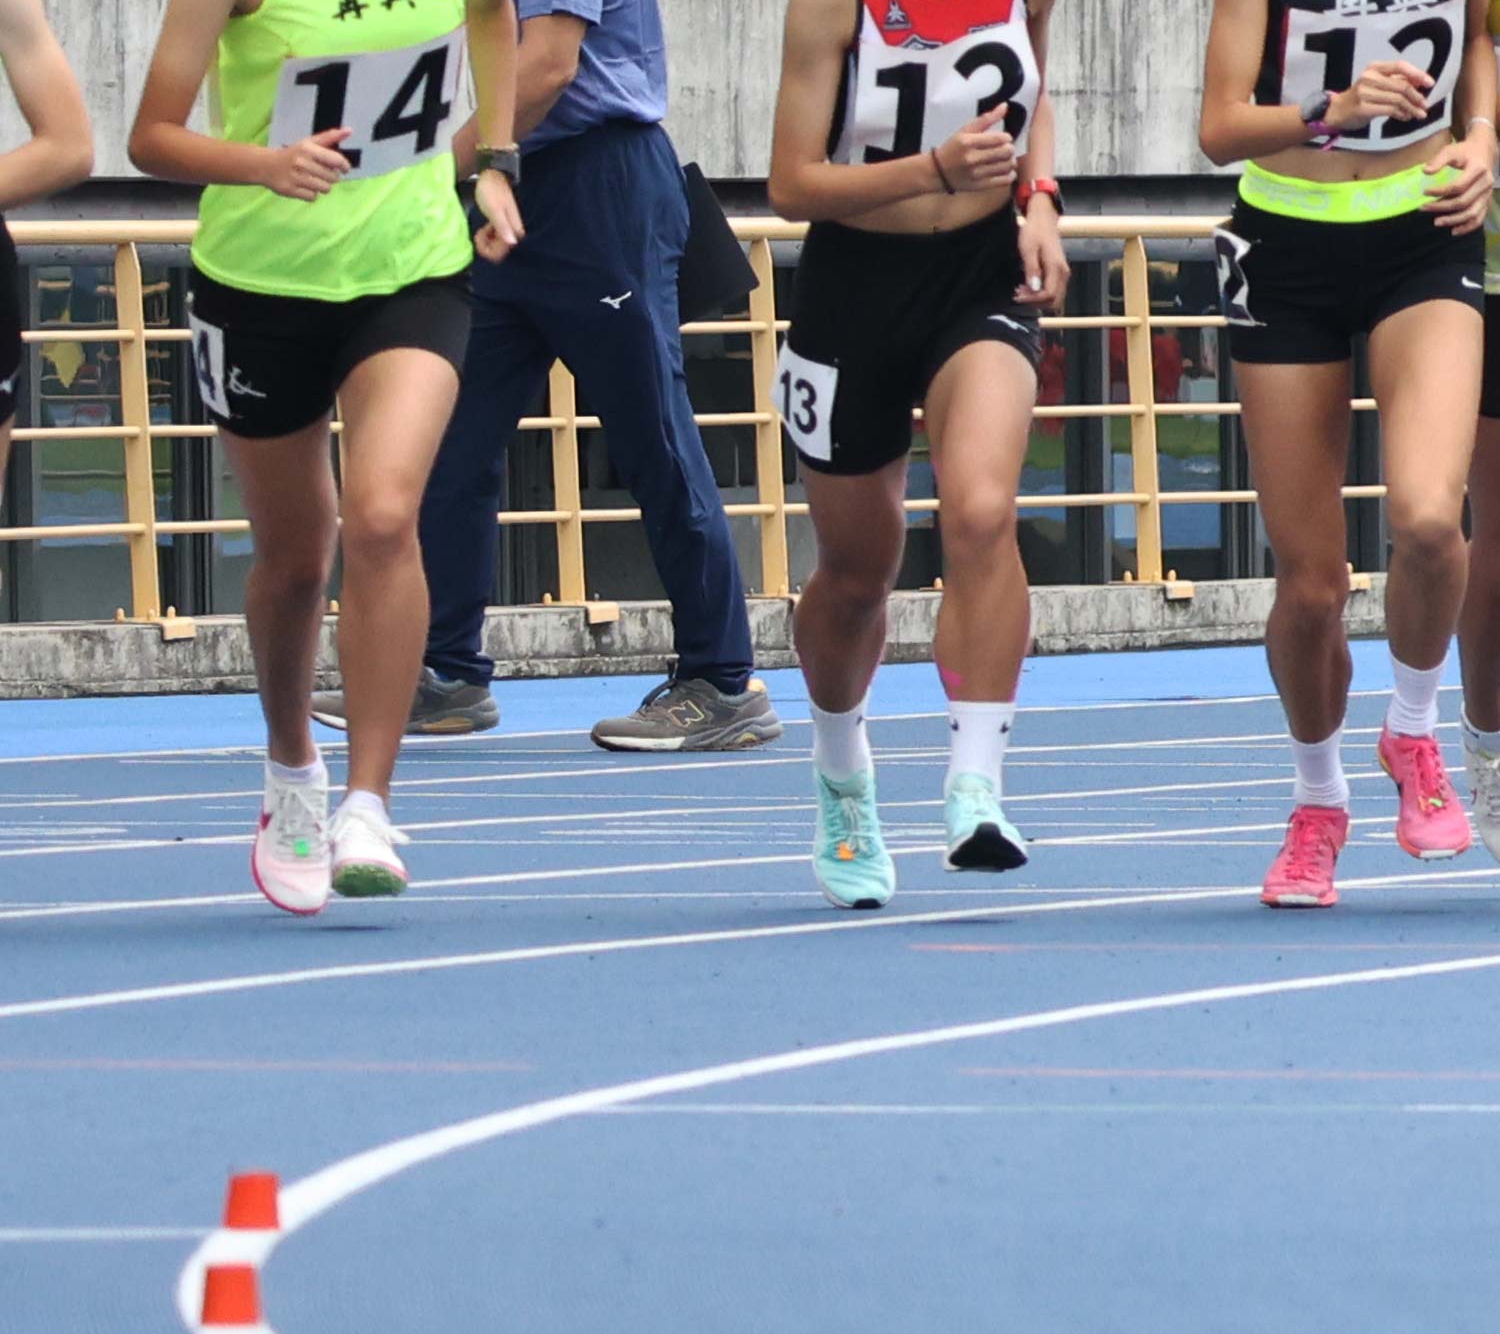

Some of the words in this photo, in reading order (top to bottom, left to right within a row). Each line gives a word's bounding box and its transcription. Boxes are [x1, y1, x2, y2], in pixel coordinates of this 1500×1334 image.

[294, 43, 452, 168] 14
[864, 41, 1027, 165] 13
[1304, 17, 1453, 139] 12
[780, 369, 818, 436] 13
